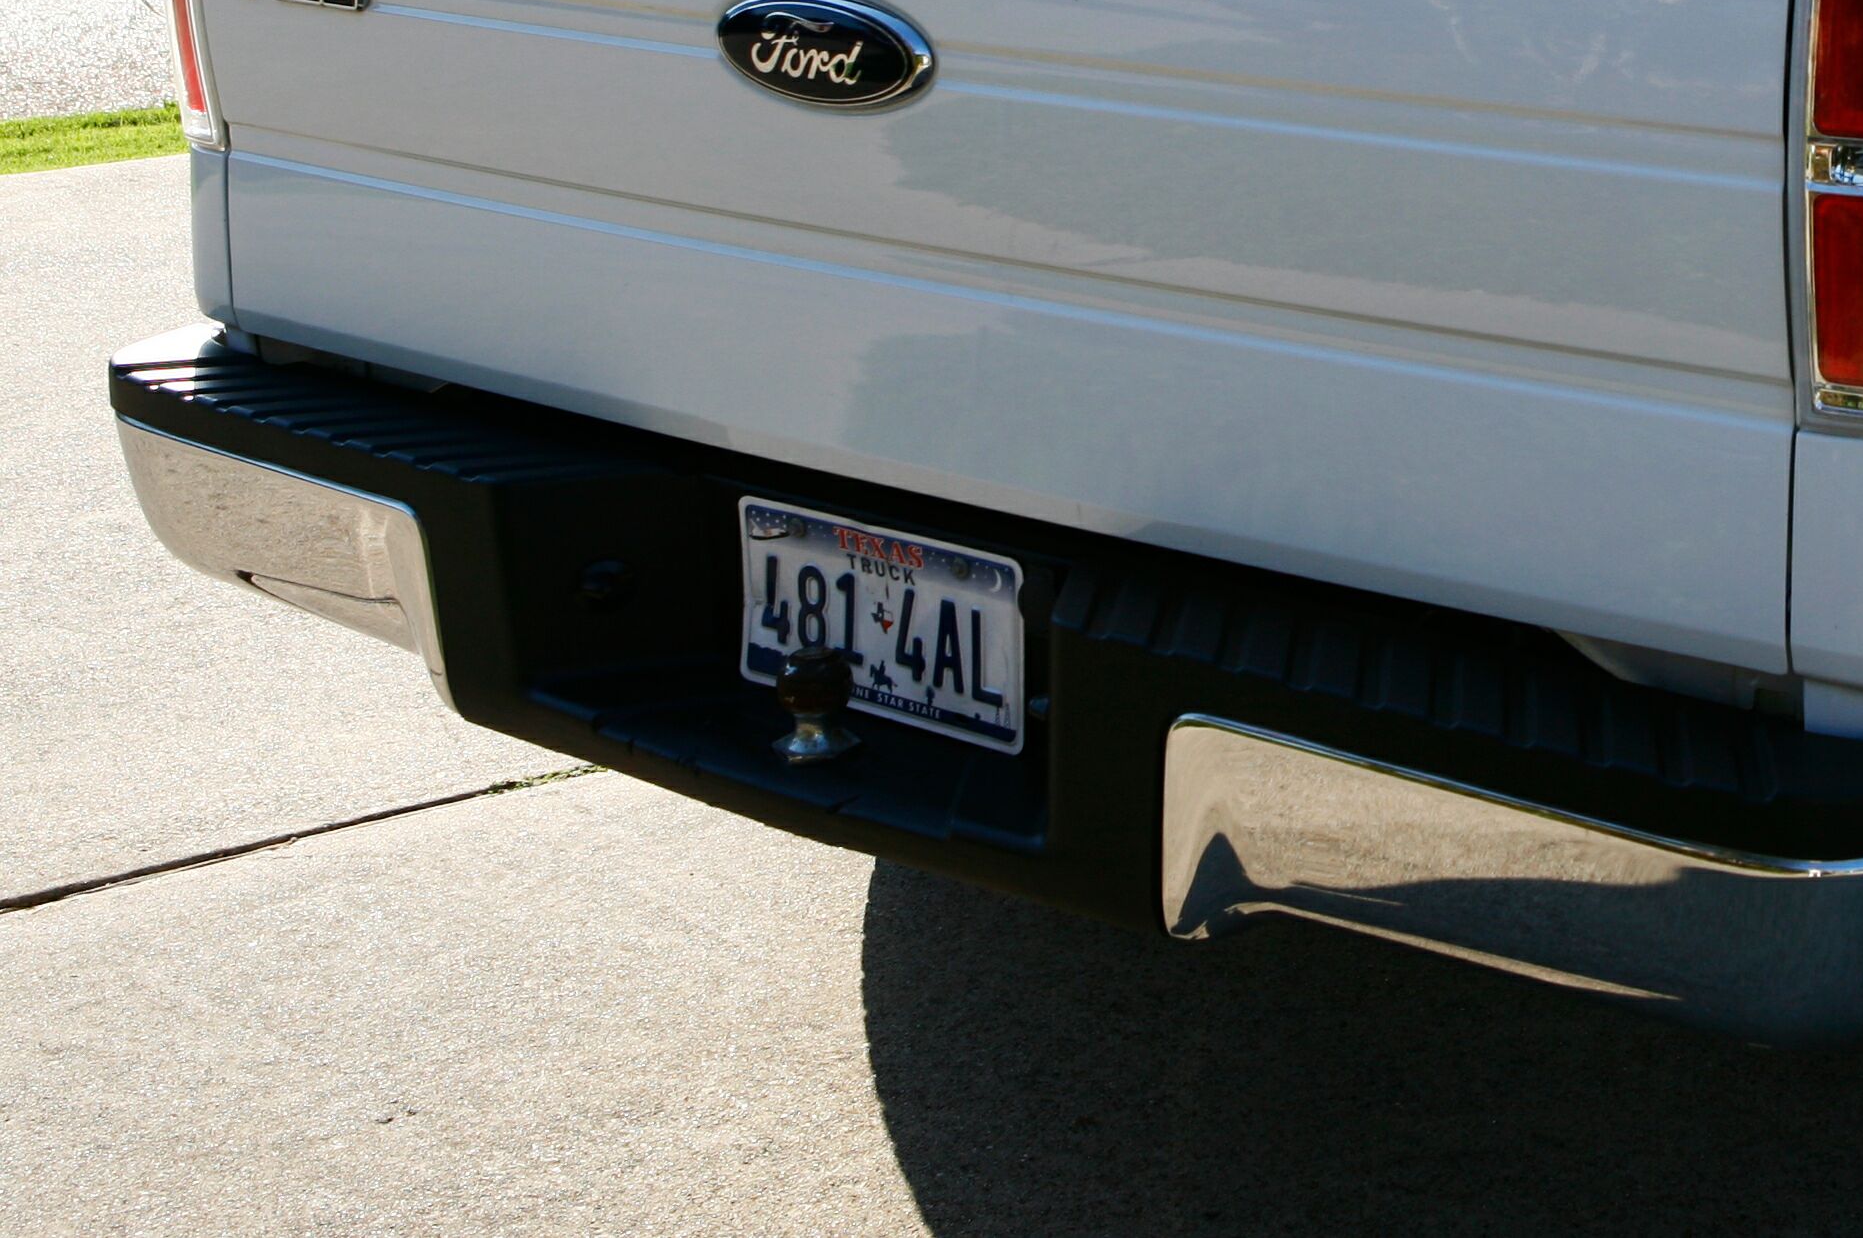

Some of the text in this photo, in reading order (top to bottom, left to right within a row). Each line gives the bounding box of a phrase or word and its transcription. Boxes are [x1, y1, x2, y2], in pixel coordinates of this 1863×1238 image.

[751, 12, 862, 85] Ford
[832, 526, 925, 570] TEXAS
[846, 553, 916, 587] TRUCK
[761, 555, 1003, 708] 481 4AL
[877, 690, 904, 709] STAR
[908, 700, 941, 719] STATE
